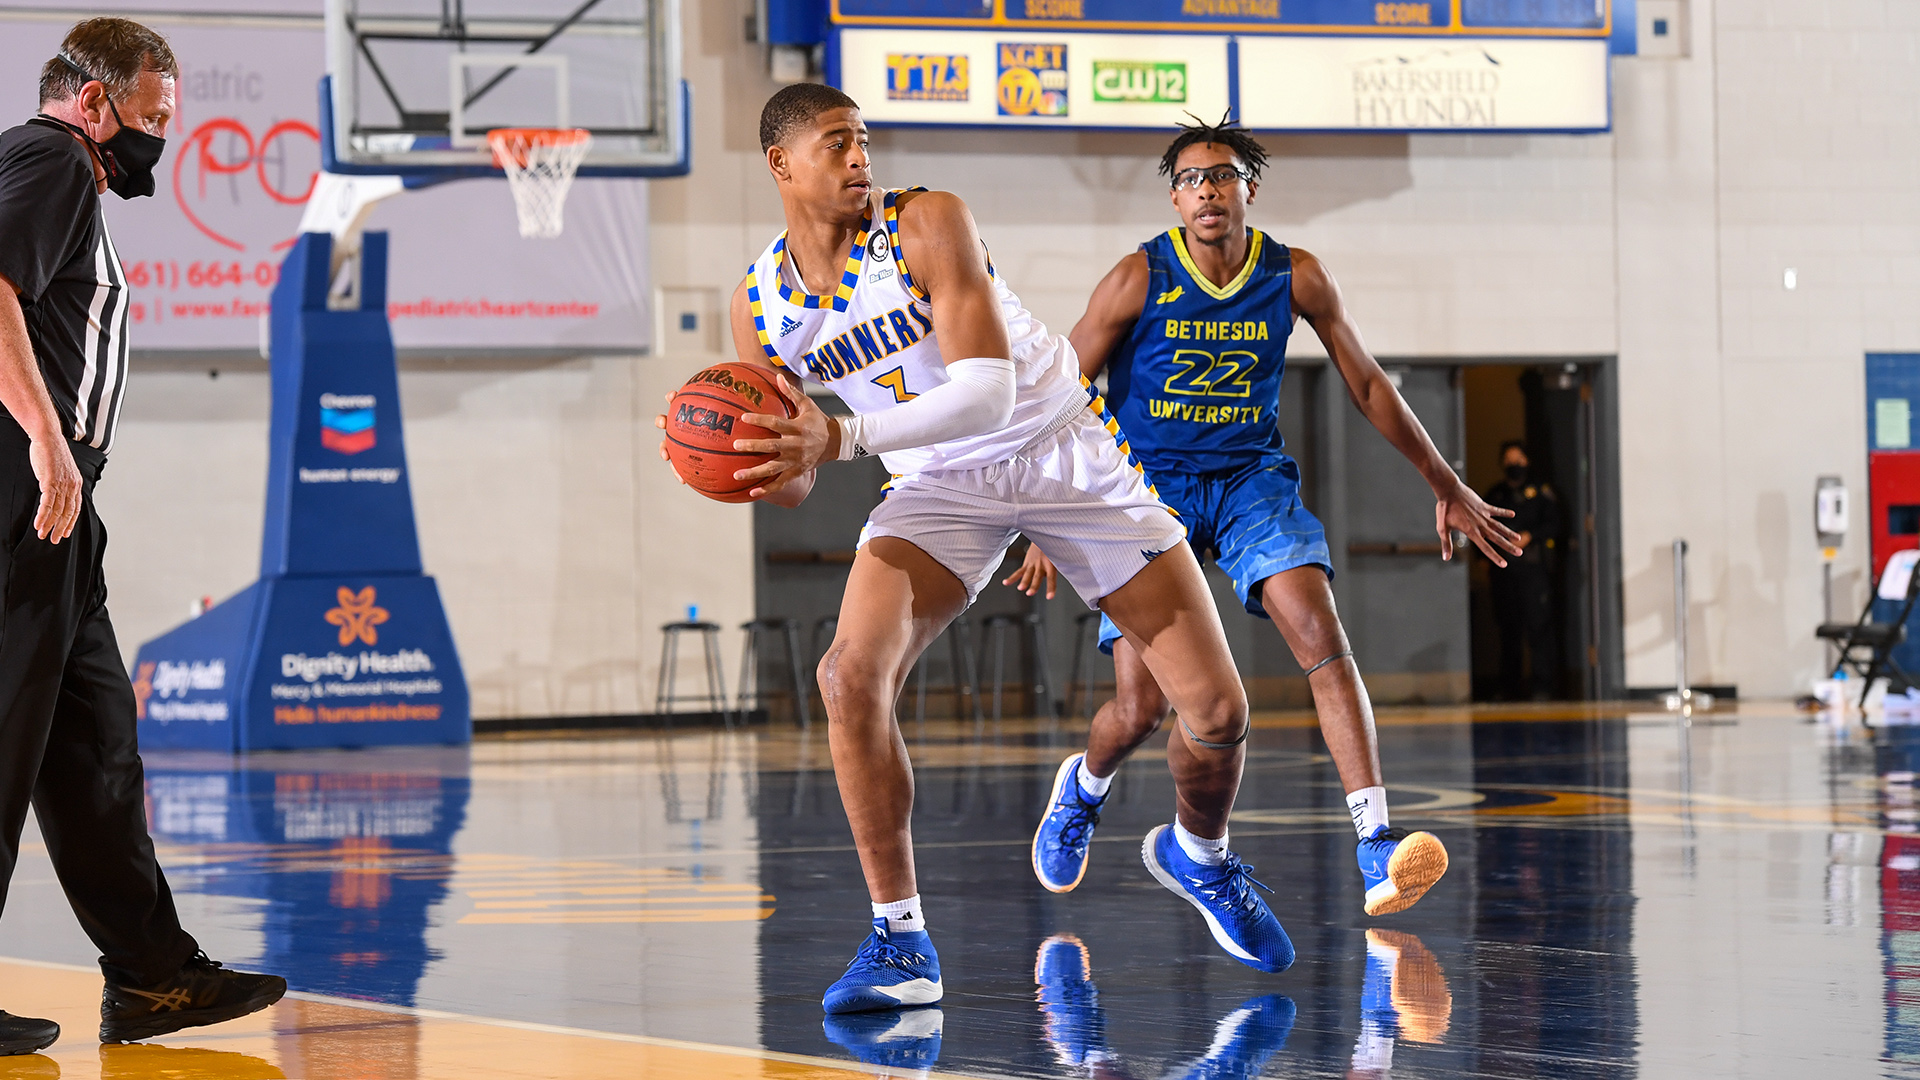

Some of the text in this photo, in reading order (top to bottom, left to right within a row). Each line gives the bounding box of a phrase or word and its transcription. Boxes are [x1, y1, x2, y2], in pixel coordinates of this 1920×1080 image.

[1374, 3, 1432, 25] SCORE
[182, 62, 265, 102] iatric
[1353, 96, 1497, 127] HYUNDAI
[779, 320, 804, 338] adidas
[800, 300, 935, 382] RUNNERS
[1165, 319, 1269, 341] BETHESDA
[1164, 349, 1259, 397] 22
[686, 369, 764, 408] Wilson
[675, 403, 735, 436] NCAA
[1149, 399, 1263, 425] UNIVERSITY
[300, 467, 400, 484] human energy
[281, 652, 359, 682] Dignity
[274, 700, 443, 725] Hello humankindness
